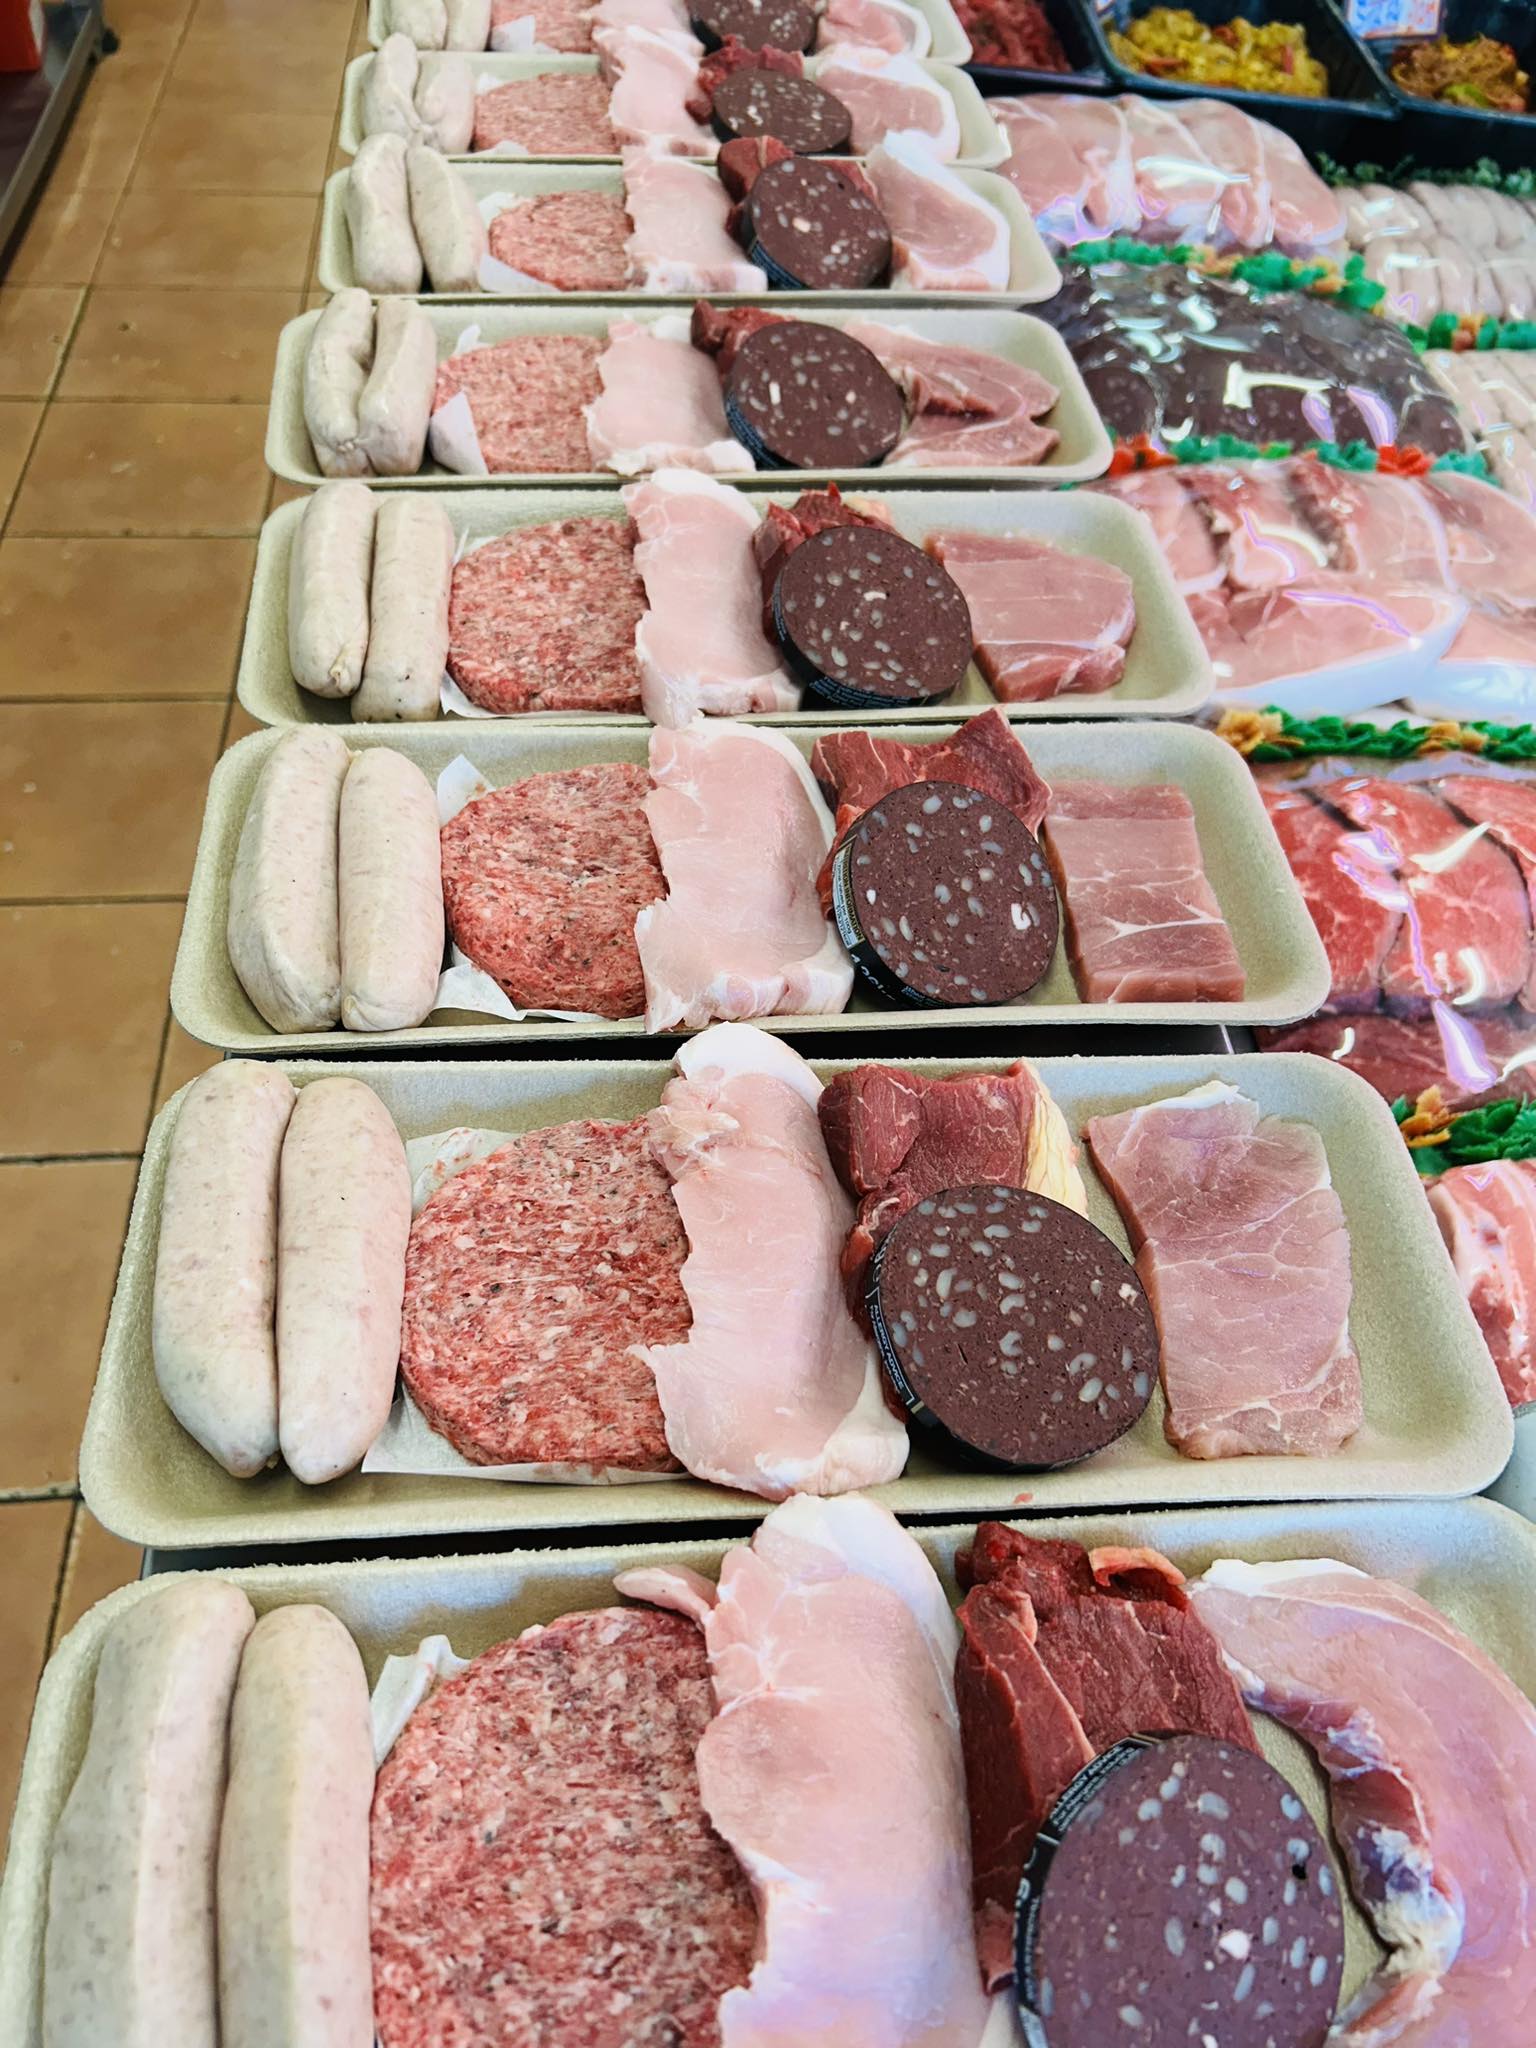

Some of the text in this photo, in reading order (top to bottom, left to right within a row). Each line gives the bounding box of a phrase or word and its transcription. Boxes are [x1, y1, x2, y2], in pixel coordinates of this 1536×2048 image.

[874, 1305, 905, 1389] ALLERGY ADVICE
[1049, 1774, 1088, 1819] ALLERGY
[1089, 1745, 1123, 1776] ADVICE
